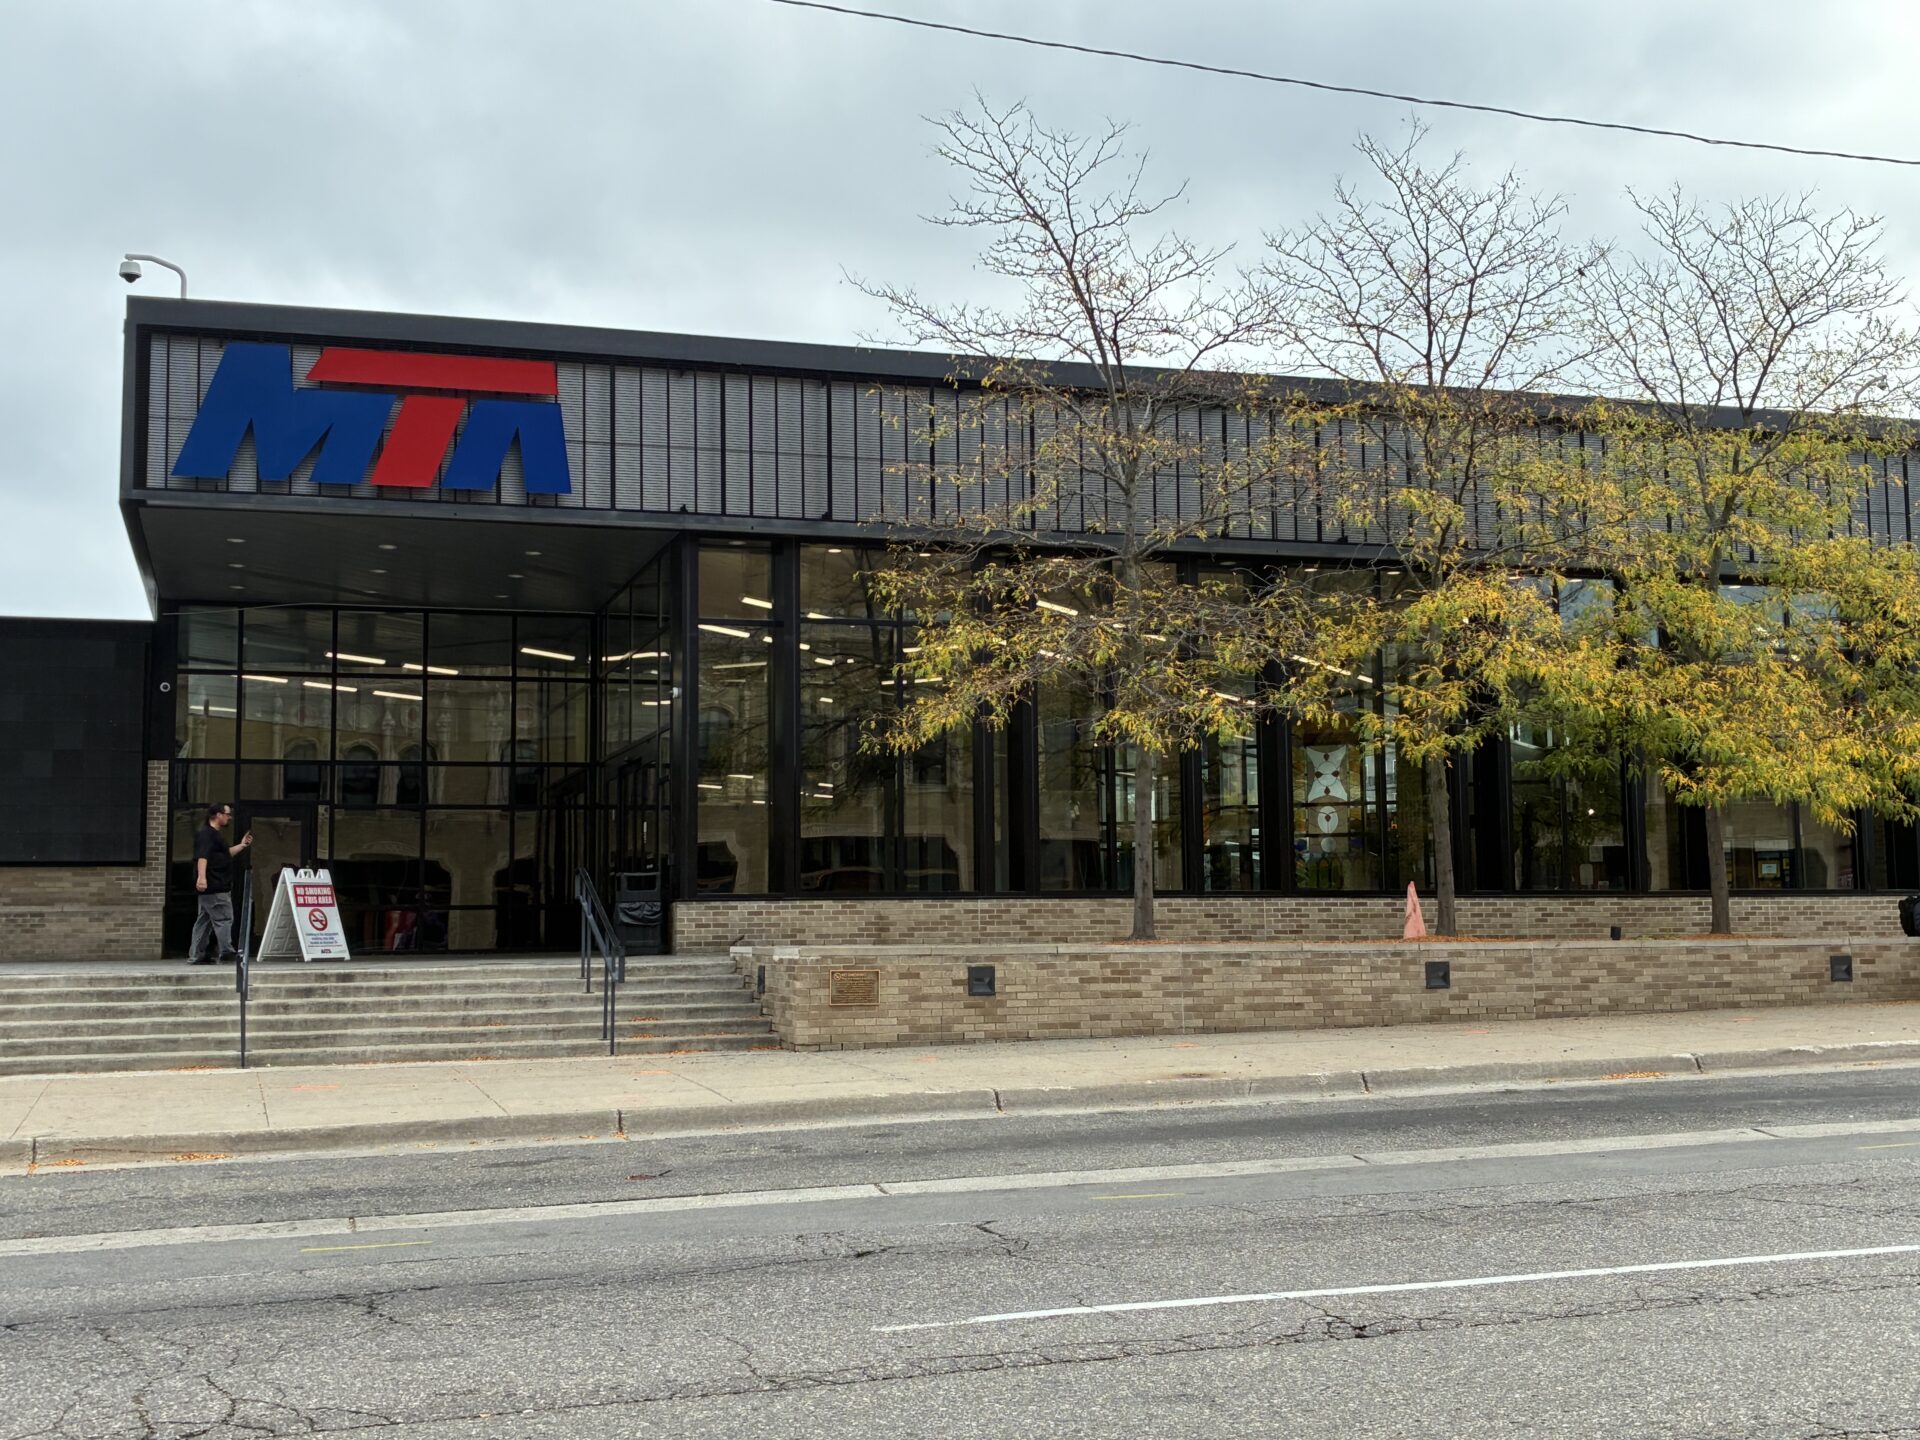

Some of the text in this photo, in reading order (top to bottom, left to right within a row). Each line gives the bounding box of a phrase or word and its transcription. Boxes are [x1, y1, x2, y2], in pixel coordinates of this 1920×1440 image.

[171, 341, 572, 494] MTA
[296, 887, 332, 895] NO SMOKING
[297, 896, 334, 904] IN THIS AREA
